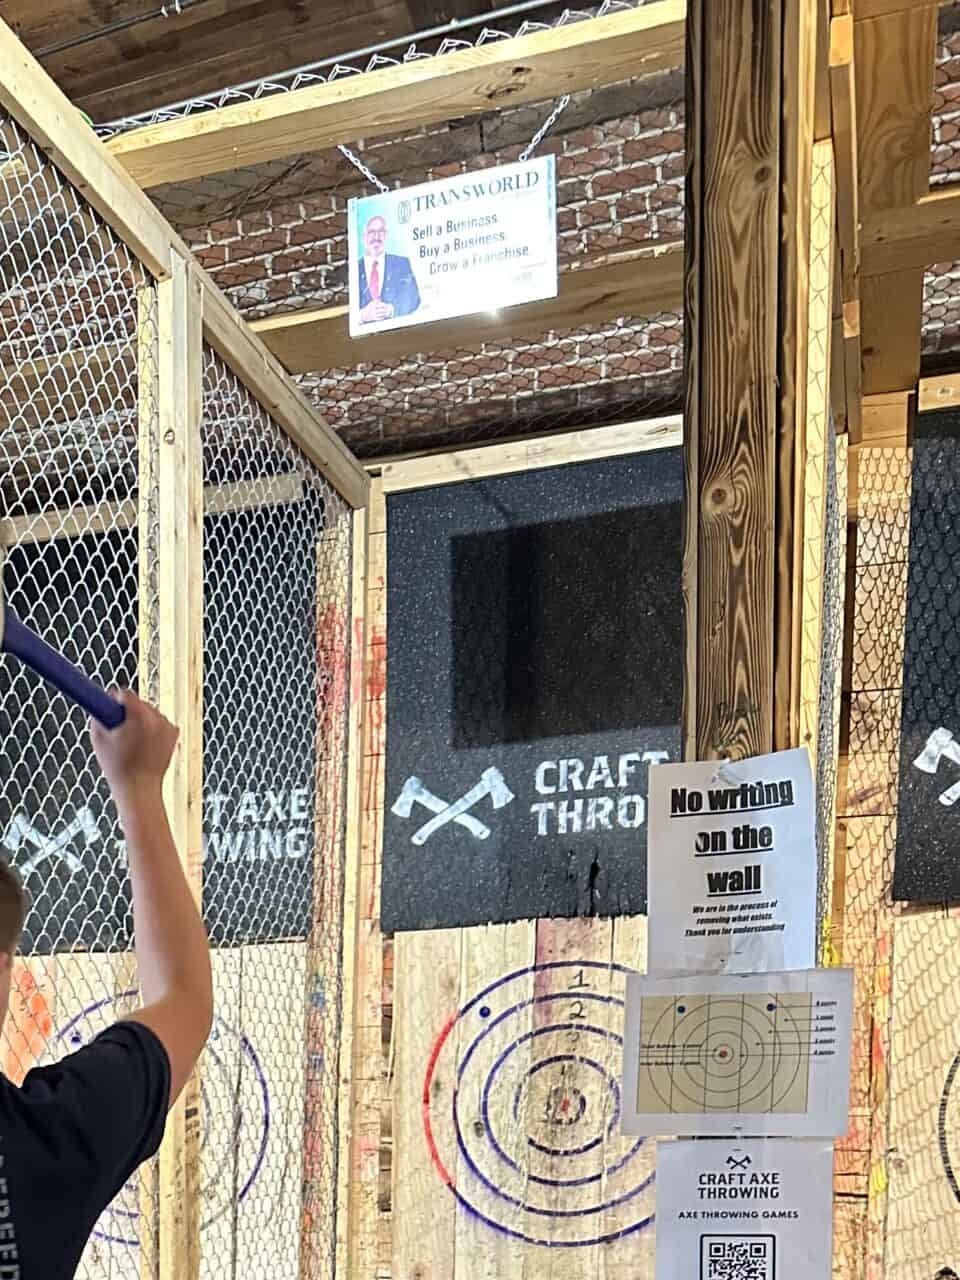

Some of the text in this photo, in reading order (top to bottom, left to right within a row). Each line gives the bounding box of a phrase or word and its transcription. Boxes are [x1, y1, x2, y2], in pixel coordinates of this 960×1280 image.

[413, 171, 540, 212] TRANSWORLD
[412, 213, 499, 241] Sell a Business
[419, 231, 506, 259] Buy a Business
[462, 257, 470, 268] a
[472, 245, 530, 266] Franchise
[671, 778, 795, 814] No writing
[530, 794, 646, 837] THRO
[208, 827, 307, 862] WING
[695, 823, 774, 853] on the
[707, 864, 763, 894] wall
[568, 969, 590, 990] 1
[568, 1000, 587, 1021] 2
[699, 1172, 781, 1186] CRAFT AXE
[697, 1187, 781, 1200] THROWING
[678, 1210, 799, 1219] AXE THROWING GAMES
